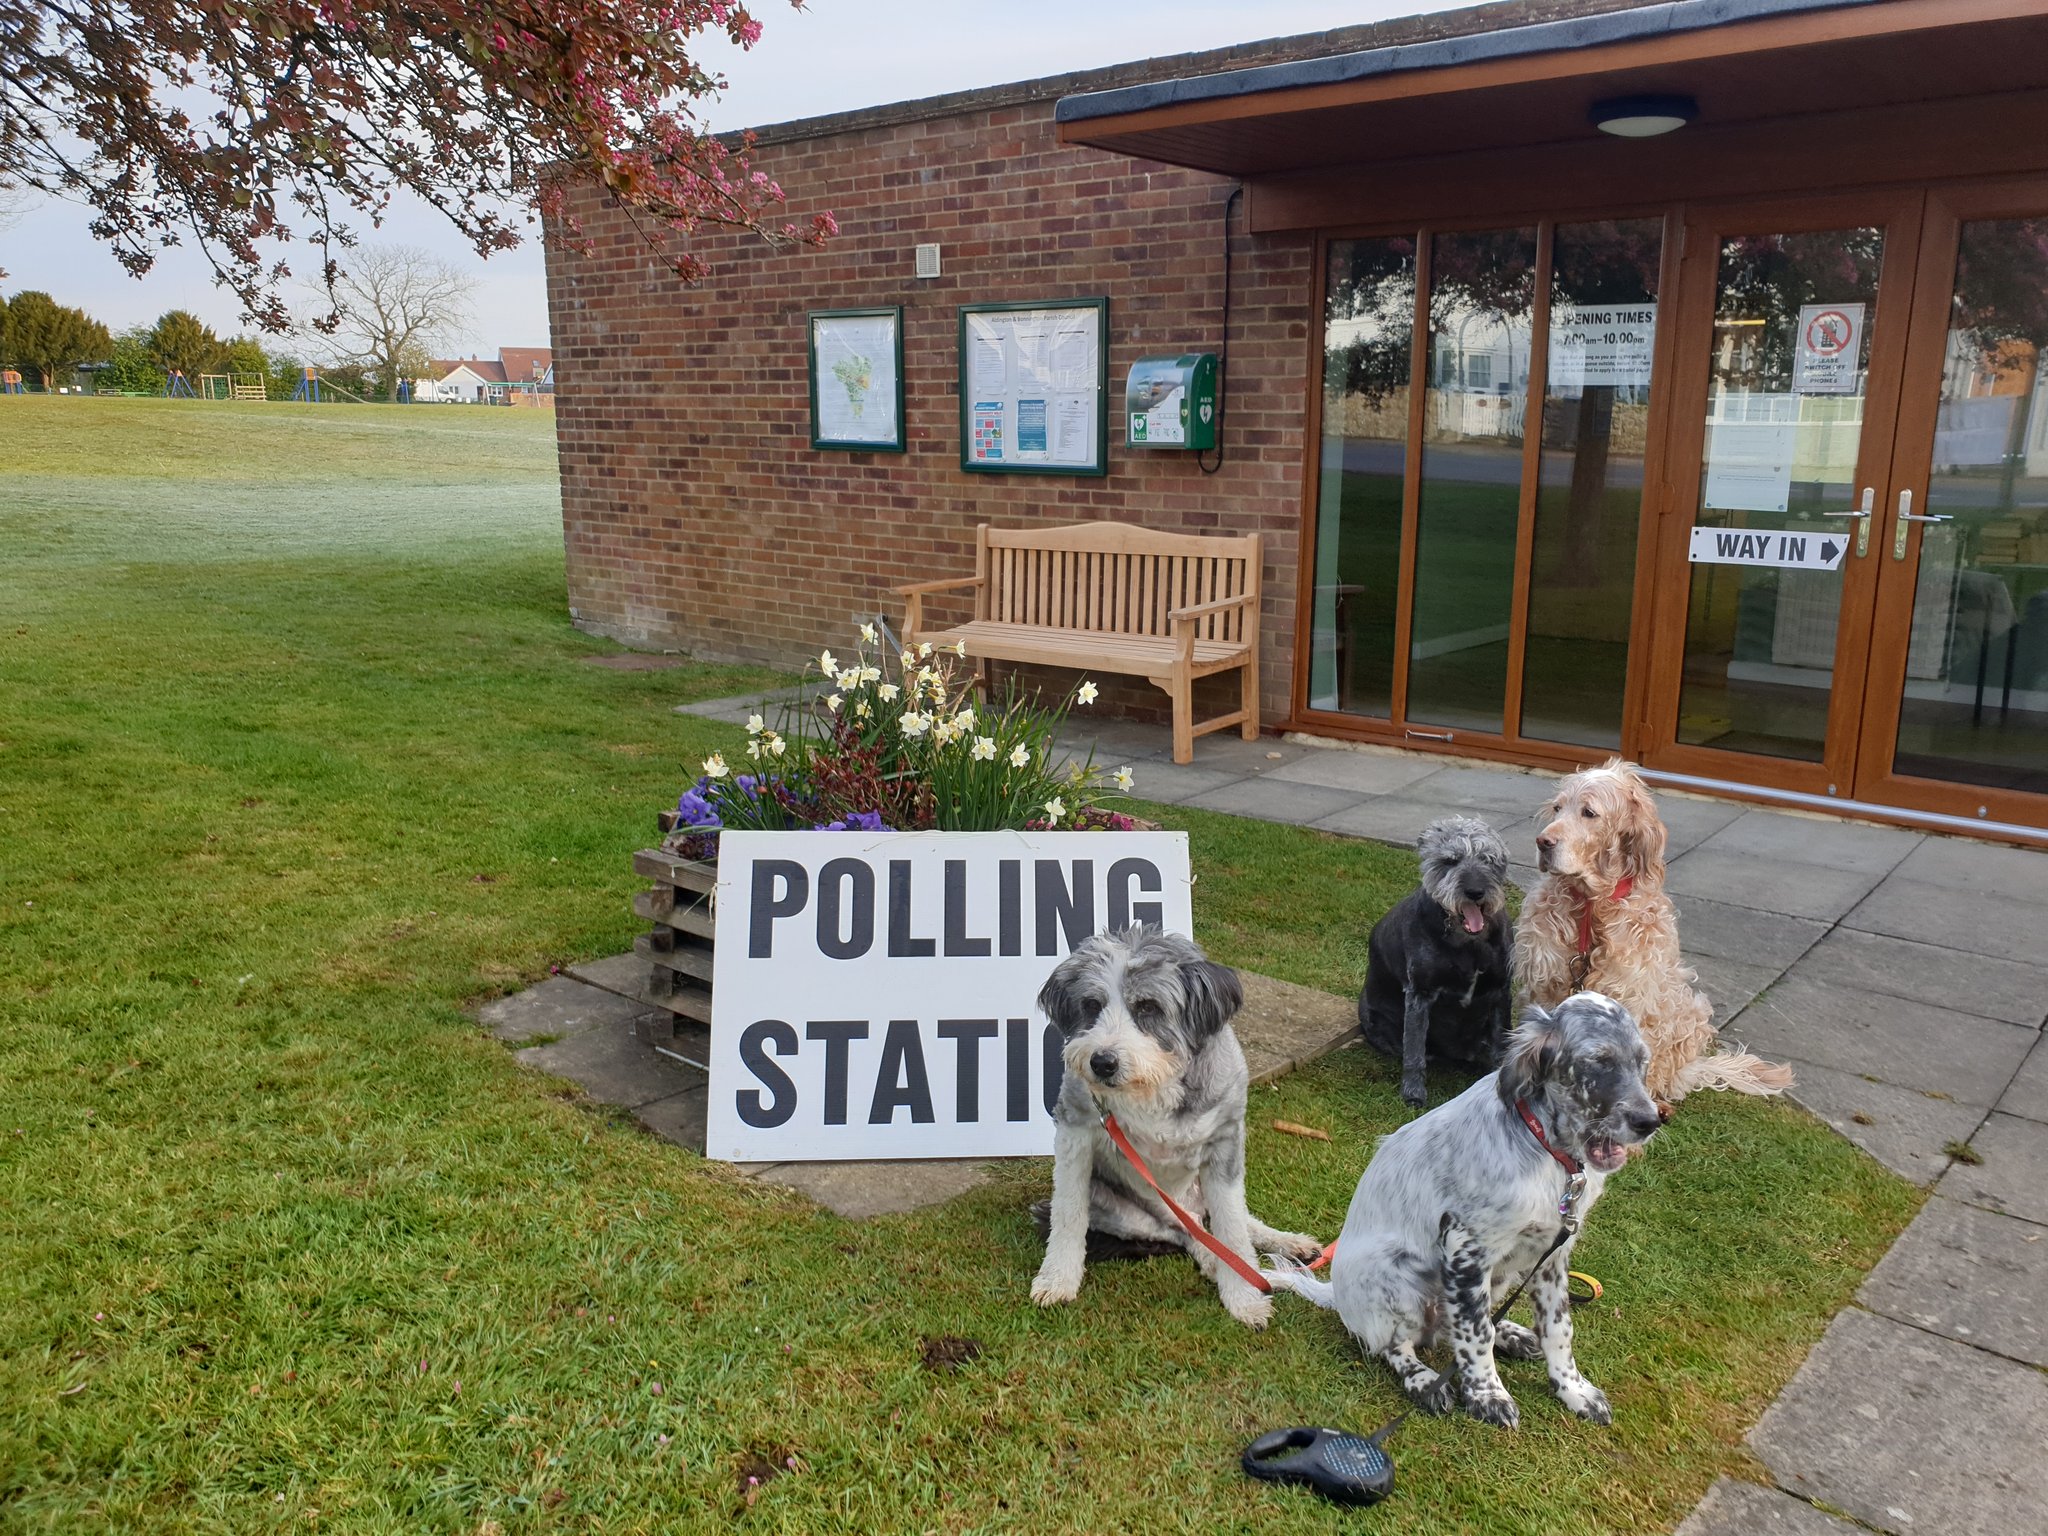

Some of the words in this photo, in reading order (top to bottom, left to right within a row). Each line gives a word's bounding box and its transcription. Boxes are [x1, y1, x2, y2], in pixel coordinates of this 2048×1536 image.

[1616, 311, 1653, 324] TIMES
[1134, 432, 1147, 440] AED
[1716, 533, 1771, 560] WAY
[1778, 536, 1807, 562] IN
[748, 857, 1163, 960] POLLING
[735, 1018, 1068, 1128] STATI
